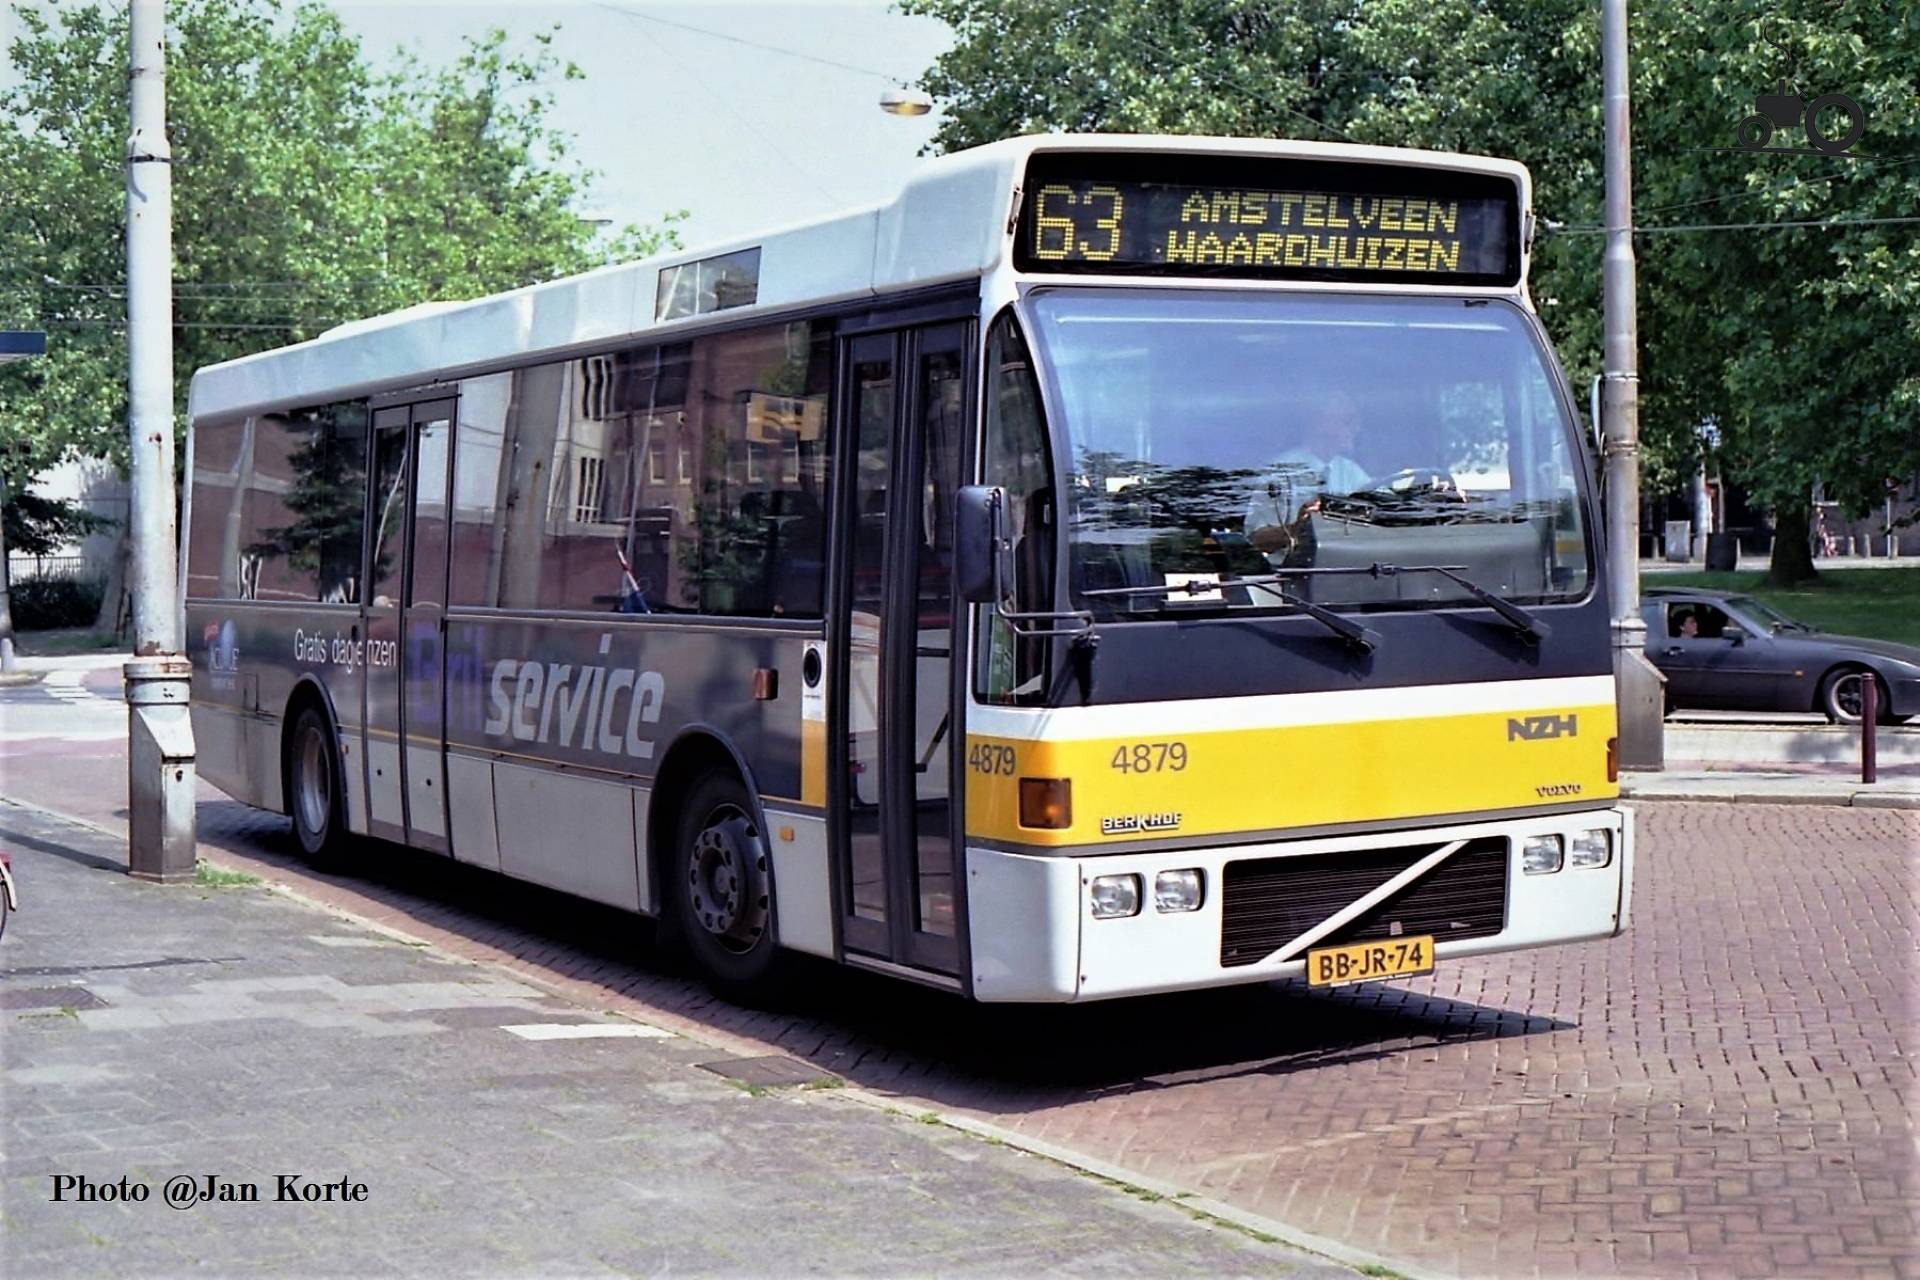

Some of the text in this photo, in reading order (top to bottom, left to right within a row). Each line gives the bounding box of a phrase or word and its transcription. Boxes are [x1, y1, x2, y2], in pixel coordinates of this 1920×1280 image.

[1035, 184, 1123, 261] 63
[1181, 190, 1457, 233] AMSTELVEEN
[1167, 229, 1460, 271] WAARDHUIZEN
[294, 628, 327, 664] Gratis
[485, 633, 666, 759] service
[1508, 714, 1577, 741] NZH
[968, 744, 1016, 775] 4879
[1111, 742, 1188, 774] 4879
[1536, 784, 1581, 797] VOLVO
[1102, 812, 1183, 834] BERKHOF
[1319, 942, 1424, 979] BB-JR-74
